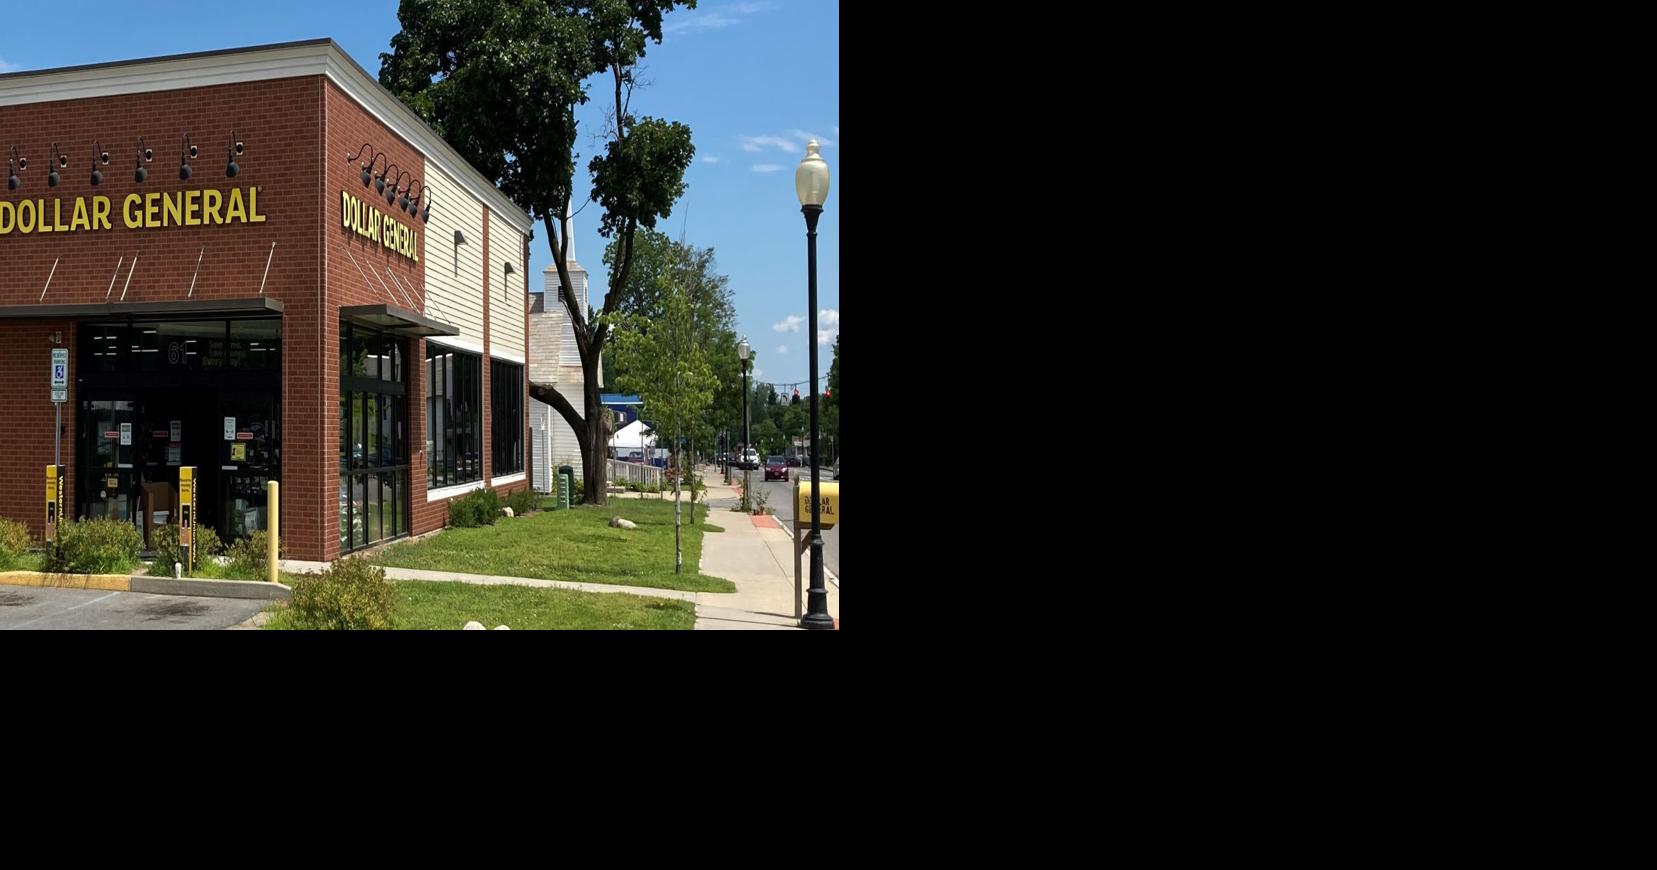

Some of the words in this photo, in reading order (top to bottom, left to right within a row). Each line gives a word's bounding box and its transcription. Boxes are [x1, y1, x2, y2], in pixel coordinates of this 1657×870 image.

[0, 195, 112, 235] DOLLAR
[123, 186, 267, 229] GENERAL
[342, 190, 382, 244] DOLLAR
[383, 213, 419, 262] GENERAL
[168, 341, 188, 365] 61
